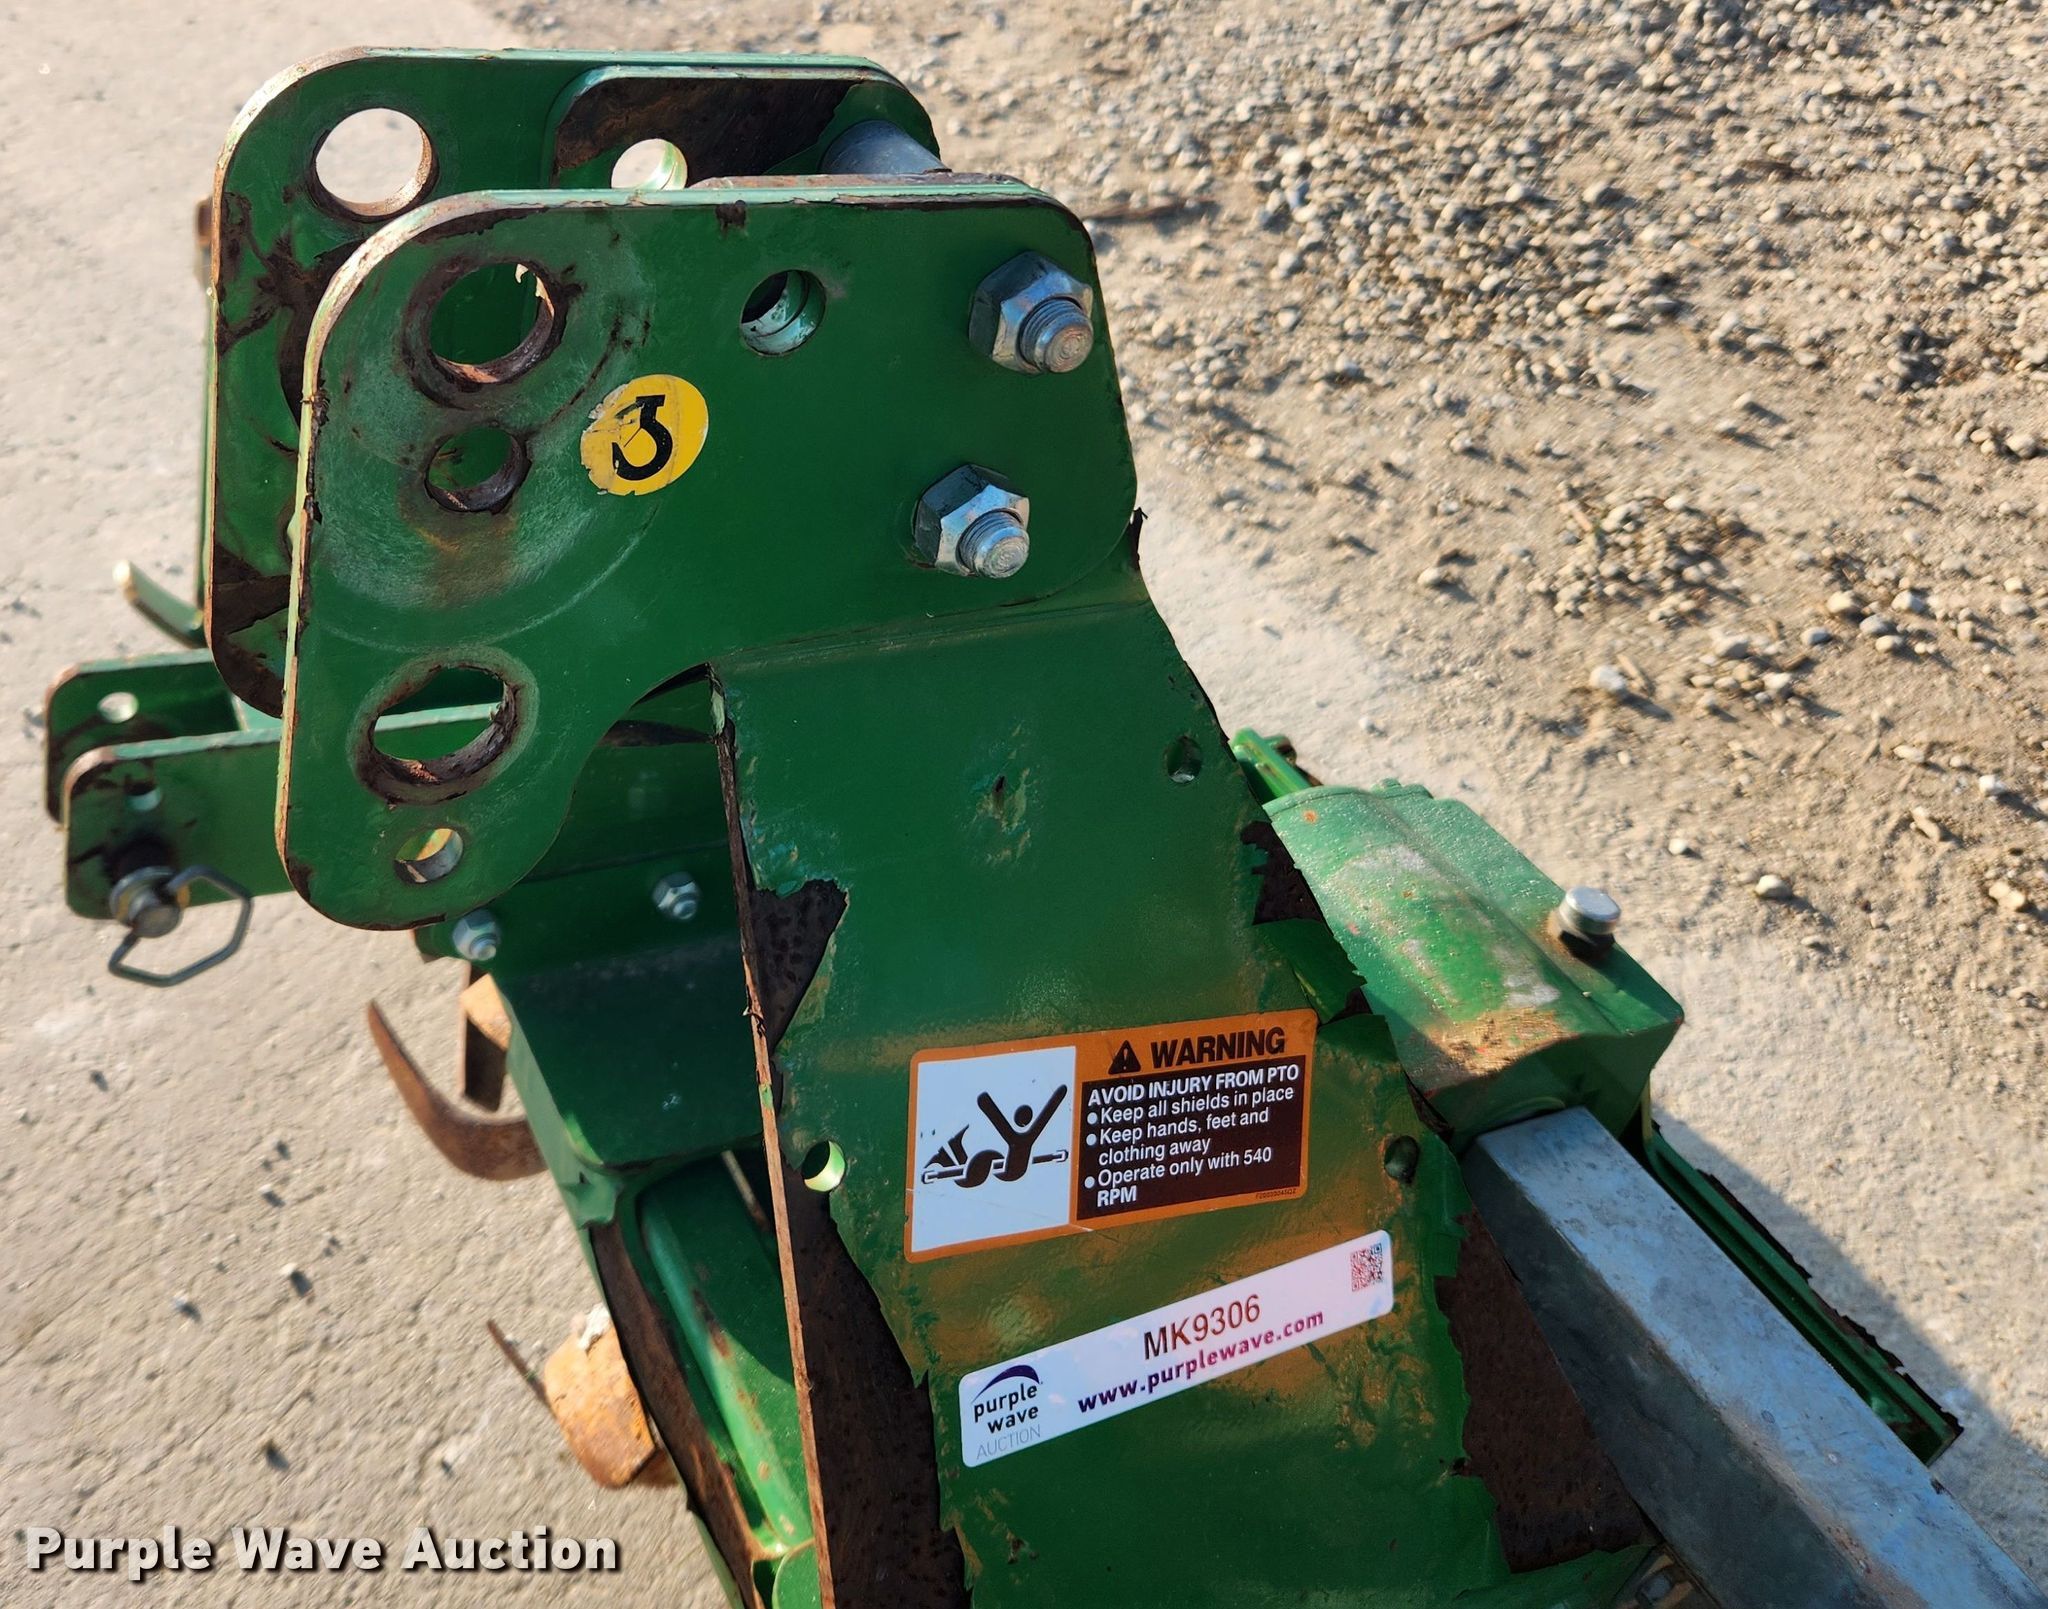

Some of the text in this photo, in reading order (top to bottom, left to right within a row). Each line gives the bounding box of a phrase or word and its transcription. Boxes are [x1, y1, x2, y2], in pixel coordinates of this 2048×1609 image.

[1150, 1027, 1285, 1069] WARNING
[1088, 1064, 1299, 1106] AVOID INJURY FROM PTO
[1100, 1086, 1294, 1125] Keep all shields in place
[1100, 1107, 1269, 1145] Keep hands, feet and
[1098, 1147, 1272, 1188] Operate only with 540
[1099, 1137, 1211, 1166] clothing away
[1097, 1185, 1137, 1208] RPM
[1143, 1294, 1261, 1361] MK9306
[1078, 1311, 1324, 1414] www.purplewave.com
[974, 1383, 1038, 1423] purple
[988, 1406, 1039, 1434] wave
[977, 1424, 1041, 1460] AUCTION
